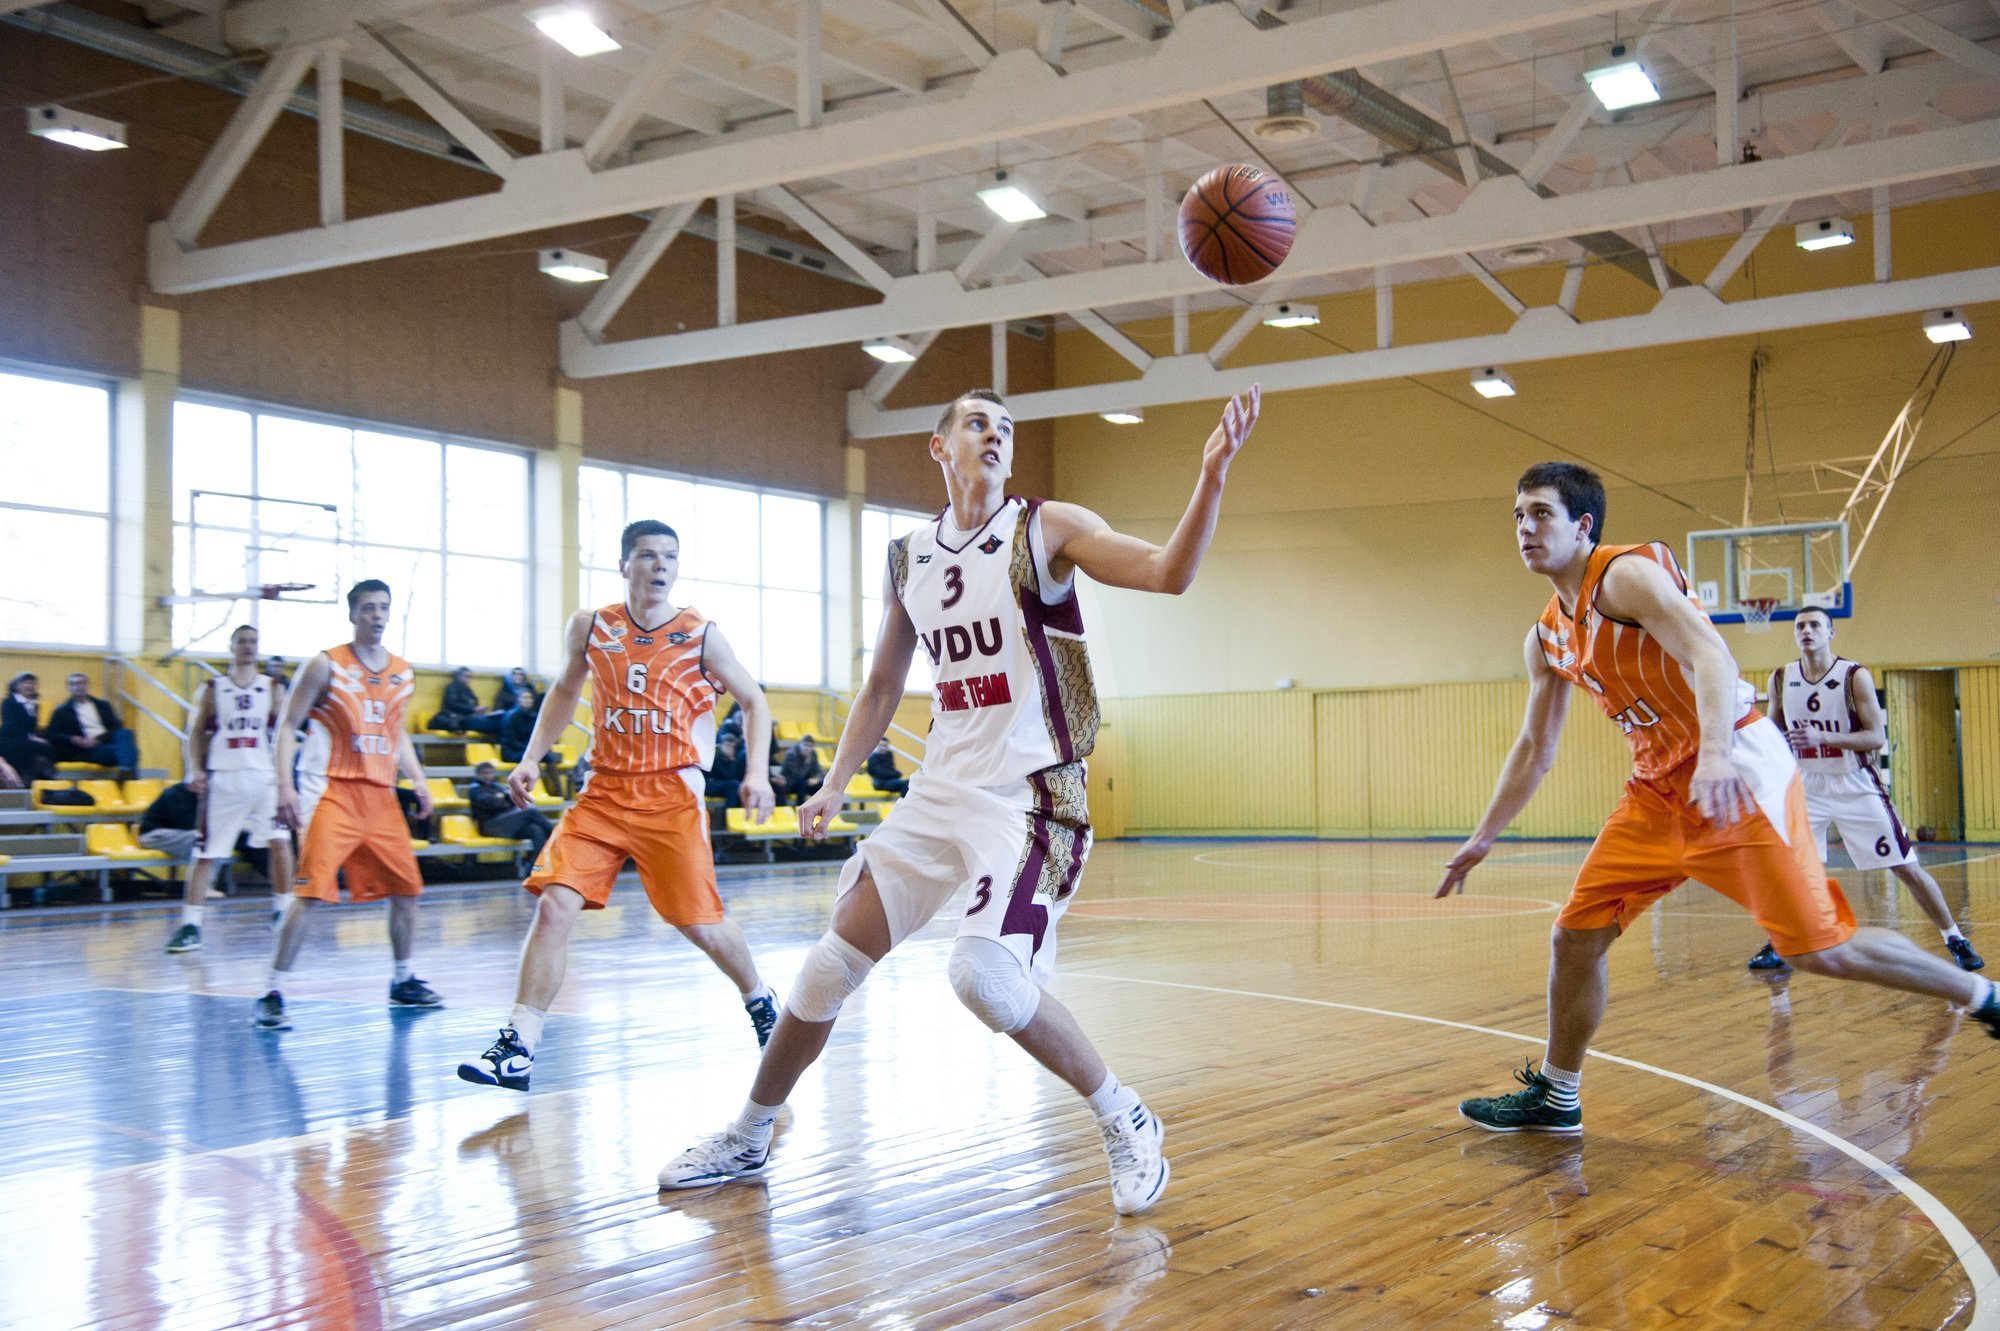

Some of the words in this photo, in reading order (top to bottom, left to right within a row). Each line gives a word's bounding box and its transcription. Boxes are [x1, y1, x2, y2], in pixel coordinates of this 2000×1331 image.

[941, 564, 965, 611] 3
[920, 617, 1003, 666] VDU
[626, 663, 648, 695] 6
[936, 680, 969, 712] TIME
[965, 672, 1012, 708] TEAM
[1807, 691, 1821, 712] 6
[604, 706, 673, 734] KTU
[1874, 835, 1891, 857] 6
[965, 874, 993, 918] 3
